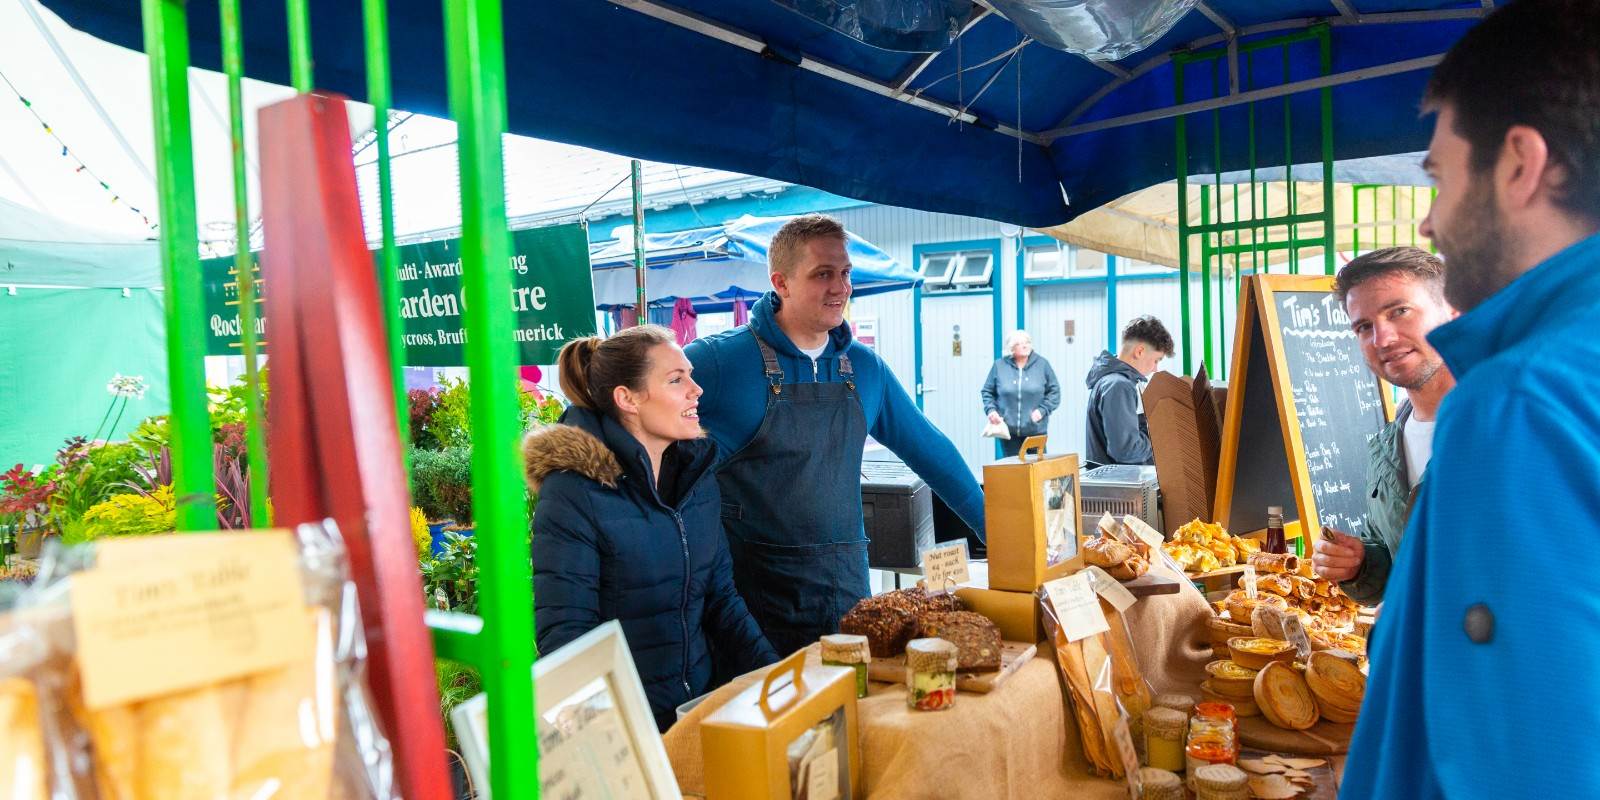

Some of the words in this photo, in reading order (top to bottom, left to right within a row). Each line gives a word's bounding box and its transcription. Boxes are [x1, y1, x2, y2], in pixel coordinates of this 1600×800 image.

[399, 288, 460, 318] arden
[1282, 295, 1320, 328] Tim's
[1321, 293, 1353, 327] Tab
[401, 330, 437, 347] ycross,
[512, 323, 564, 342] merick
